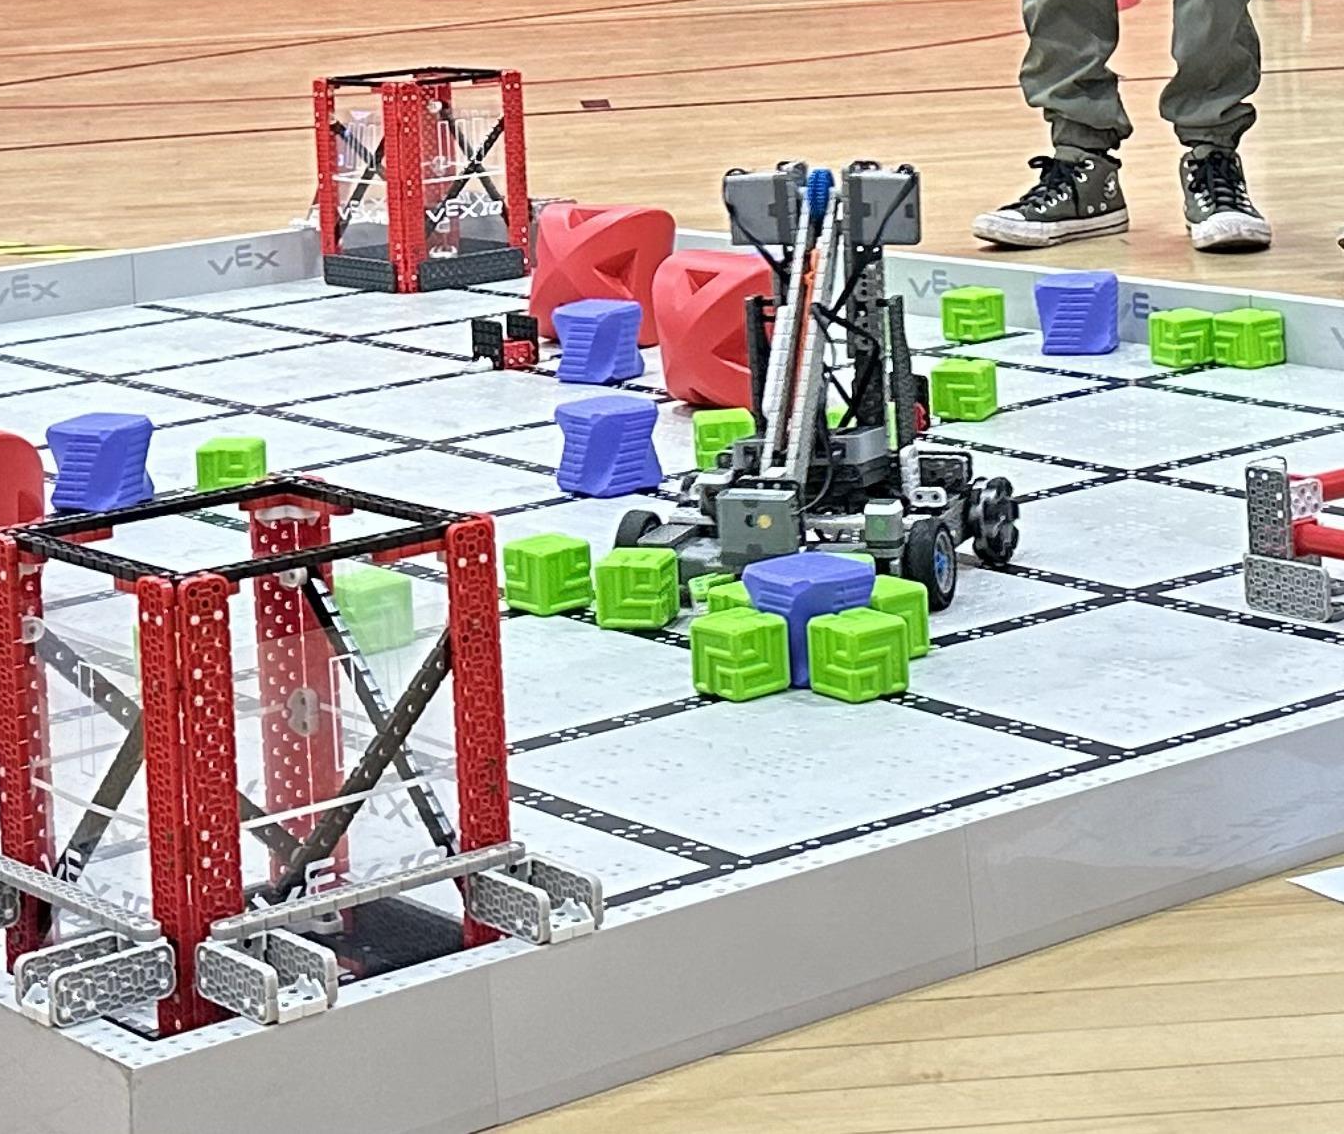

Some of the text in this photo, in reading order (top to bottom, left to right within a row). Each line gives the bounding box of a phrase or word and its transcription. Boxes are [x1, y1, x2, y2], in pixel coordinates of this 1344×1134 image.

[427, 199, 476, 223] VEX
[208, 244, 280, 276] VEX
[908, 269, 956, 298] VE
